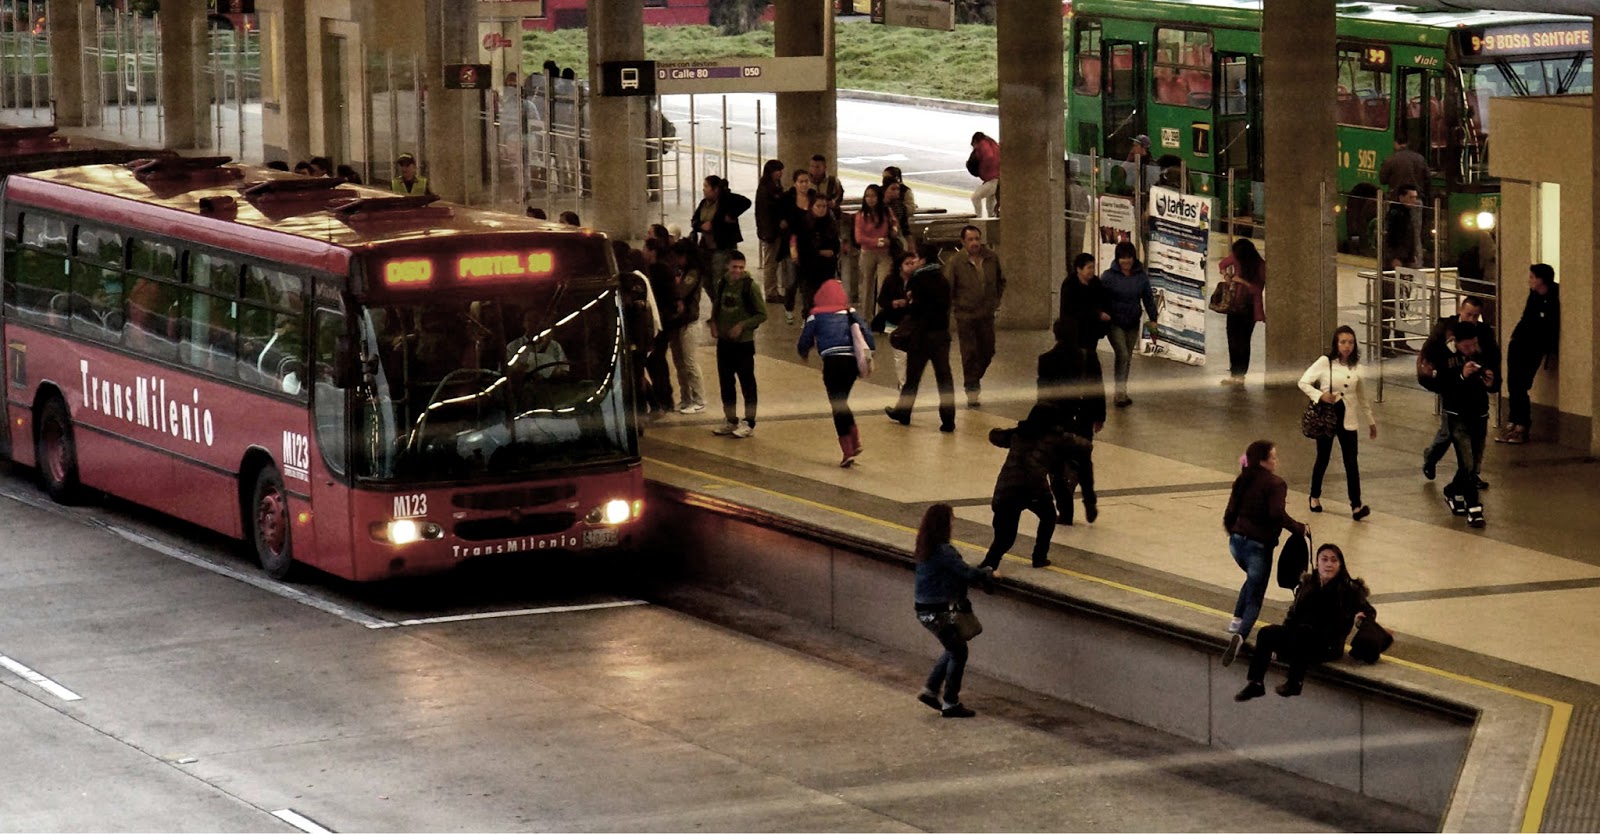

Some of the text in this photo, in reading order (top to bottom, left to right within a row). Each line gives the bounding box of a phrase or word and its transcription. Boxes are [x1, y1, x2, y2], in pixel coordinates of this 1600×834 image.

[1471, 30, 1590, 51] 9-9 BOSA SANTAFE
[659, 69, 709, 78] D Calle 80
[744, 67, 760, 76] D50
[1358, 149, 1377, 169] 5057
[1167, 195, 1197, 218] tarifas
[80, 359, 213, 447] TransMilenio
[283, 430, 309, 469] M123
[394, 493, 427, 517] M123
[452, 535, 577, 557] TransMilenio
